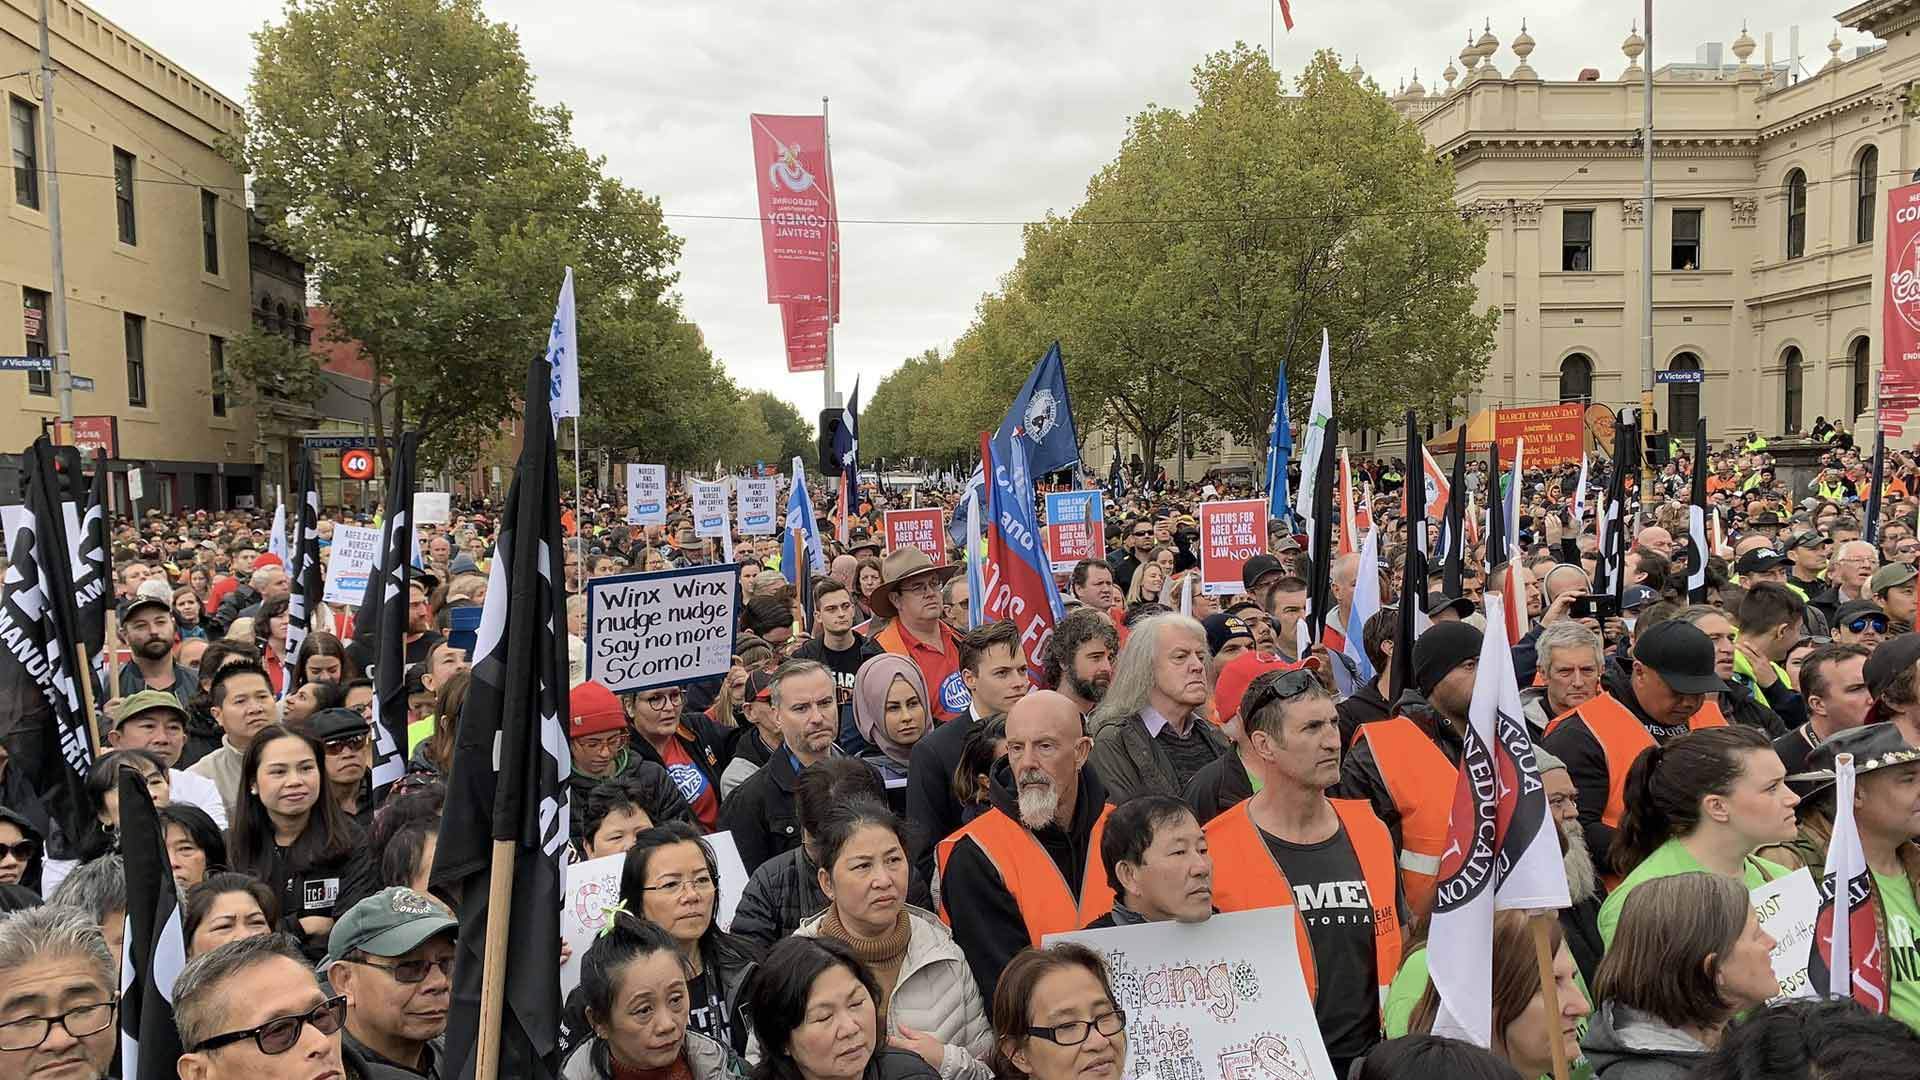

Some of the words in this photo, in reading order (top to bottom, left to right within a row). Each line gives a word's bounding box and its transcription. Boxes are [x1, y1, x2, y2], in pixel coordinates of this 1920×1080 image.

[9, 359, 40, 367] Victoria
[42, 359, 51, 367] St
[1664, 372, 1692, 380] Victoria
[1692, 372, 1701, 380] St
[1542, 409, 1559, 418] MAY
[1562, 407, 1578, 417] DAY
[1523, 434, 1544, 444] NDAY
[348, 457, 367, 471] 40
[1210, 512, 1238, 524] RATIOS
[1240, 511, 1255, 522] FOR
[895, 520, 919, 531] RATIOS
[920, 519, 934, 530] FOR
[1211, 524, 1230, 535] AGED
[1232, 523, 1252, 534] CARE
[896, 531, 913, 542] AGED
[915, 530, 933, 540] CARE
[1211, 535, 1232, 546] MAKE
[1234, 534, 1257, 545] THEM
[1211, 547, 1229, 558] LAW
[1229, 547, 1262, 561] NOW
[600, 586, 661, 610] Winx
[673, 579, 728, 598] Winx
[597, 609, 662, 637] nudge
[668, 601, 728, 625] nudge
[597, 638, 640, 662] Say
[645, 633, 672, 649] no
[676, 625, 728, 646] more
[603, 646, 701, 684] Scomo!
[1437, 758, 1497, 907] EDUCATION
[1110, 952, 1259, 1018] hange
[1130, 1016, 1189, 1055] the
